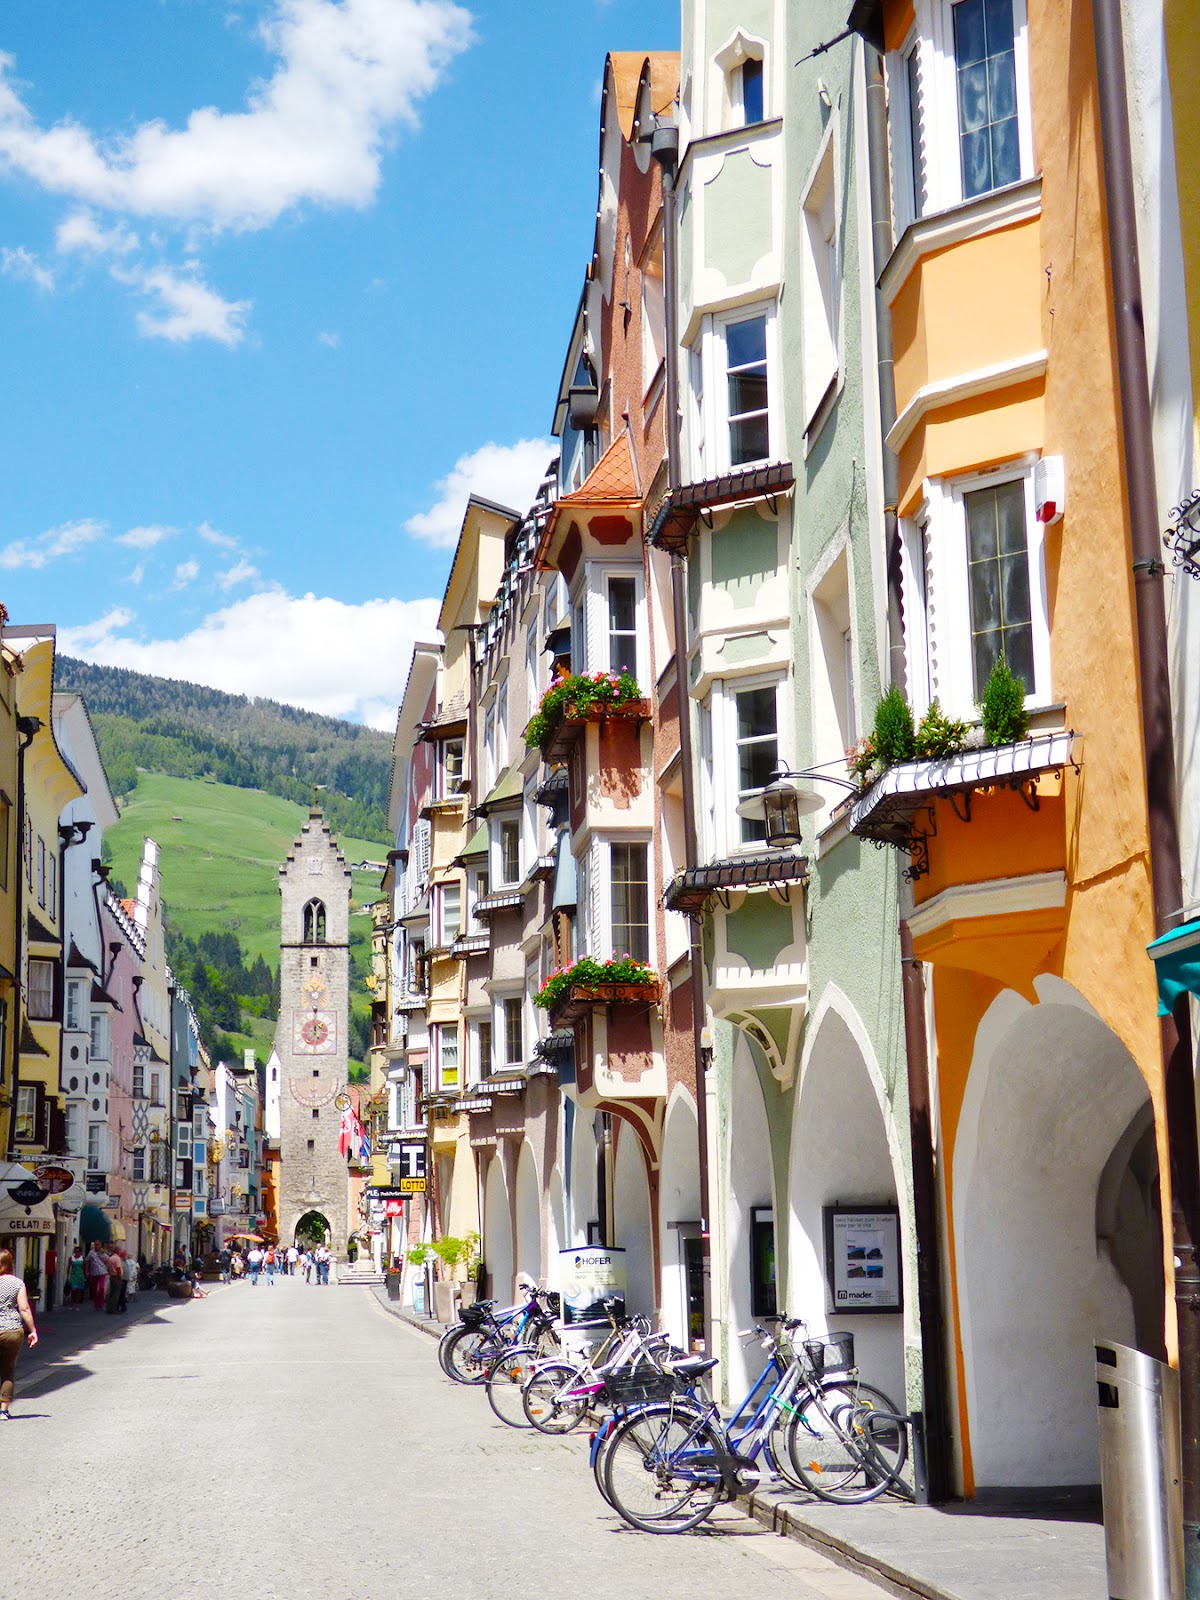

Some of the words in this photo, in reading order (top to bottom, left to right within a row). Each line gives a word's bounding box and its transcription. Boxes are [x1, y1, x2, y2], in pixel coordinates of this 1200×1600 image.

[402, 1181, 425, 1190] LOTTO
[387, 1201, 402, 1215] illy
[9, 1220, 39, 1229] GELATI
[43, 1221, 51, 1229] EIS
[582, 1257, 611, 1265] HOFER
